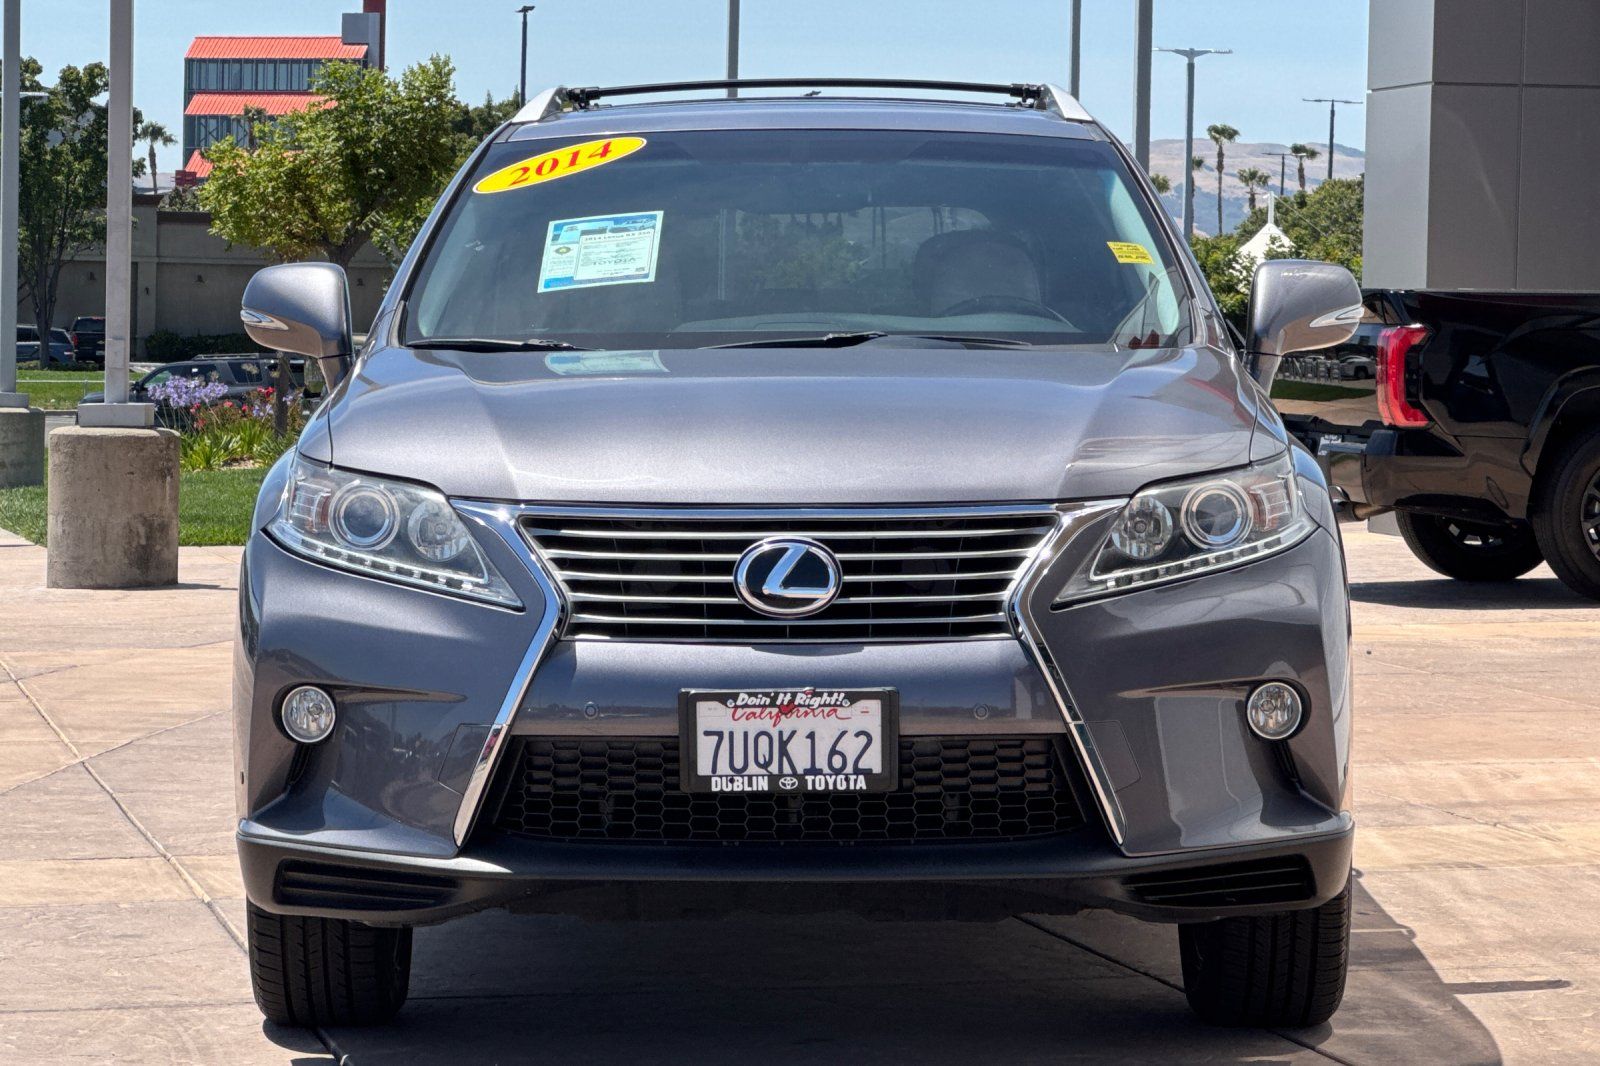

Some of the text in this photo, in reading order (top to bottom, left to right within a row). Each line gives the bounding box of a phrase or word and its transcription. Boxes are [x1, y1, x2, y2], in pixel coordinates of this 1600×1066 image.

[508, 141, 612, 187] 2014
[736, 692, 774, 707] Doin'
[776, 693, 792, 706] It
[794, 693, 845, 709] Right!
[703, 730, 873, 774] 7UQK162
[711, 775, 867, 792] DUBLIN TOYOTA
